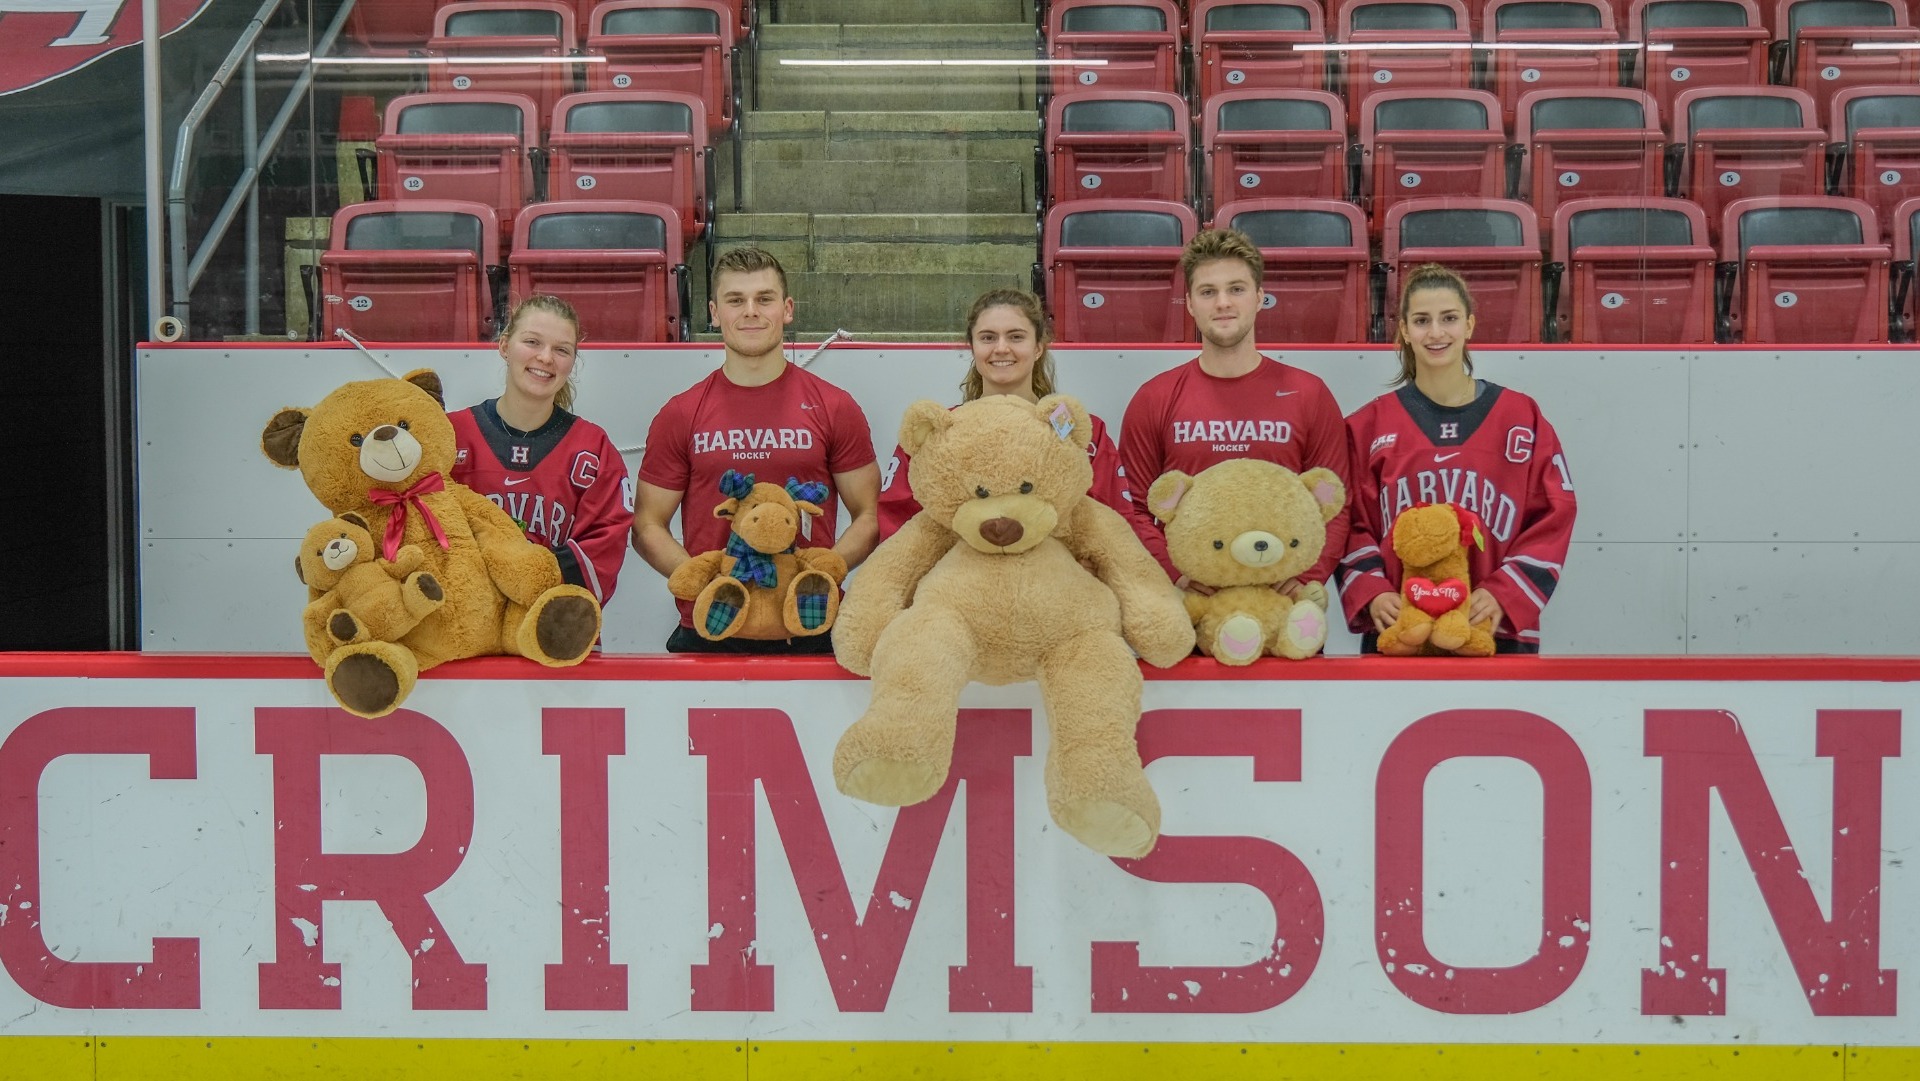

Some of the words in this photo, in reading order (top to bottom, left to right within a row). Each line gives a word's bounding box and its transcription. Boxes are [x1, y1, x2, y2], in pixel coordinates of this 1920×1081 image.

[693, 428, 813, 454] HARVARD
[1174, 420, 1291, 444] HARVARD
[1440, 422, 1458, 439] H
[511, 446, 530, 464] H
[732, 451, 771, 460] HOCKEY
[1212, 443, 1250, 452] HOCKEY
[1505, 425, 1535, 464] C
[570, 450, 600, 489] C
[1380, 468, 1516, 542] HARVARD
[1411, 584, 1431, 601] You
[1432, 588, 1440, 597] &
[1439, 587, 1460, 602] Me
[0, 706, 1902, 1016] CRIMSON
